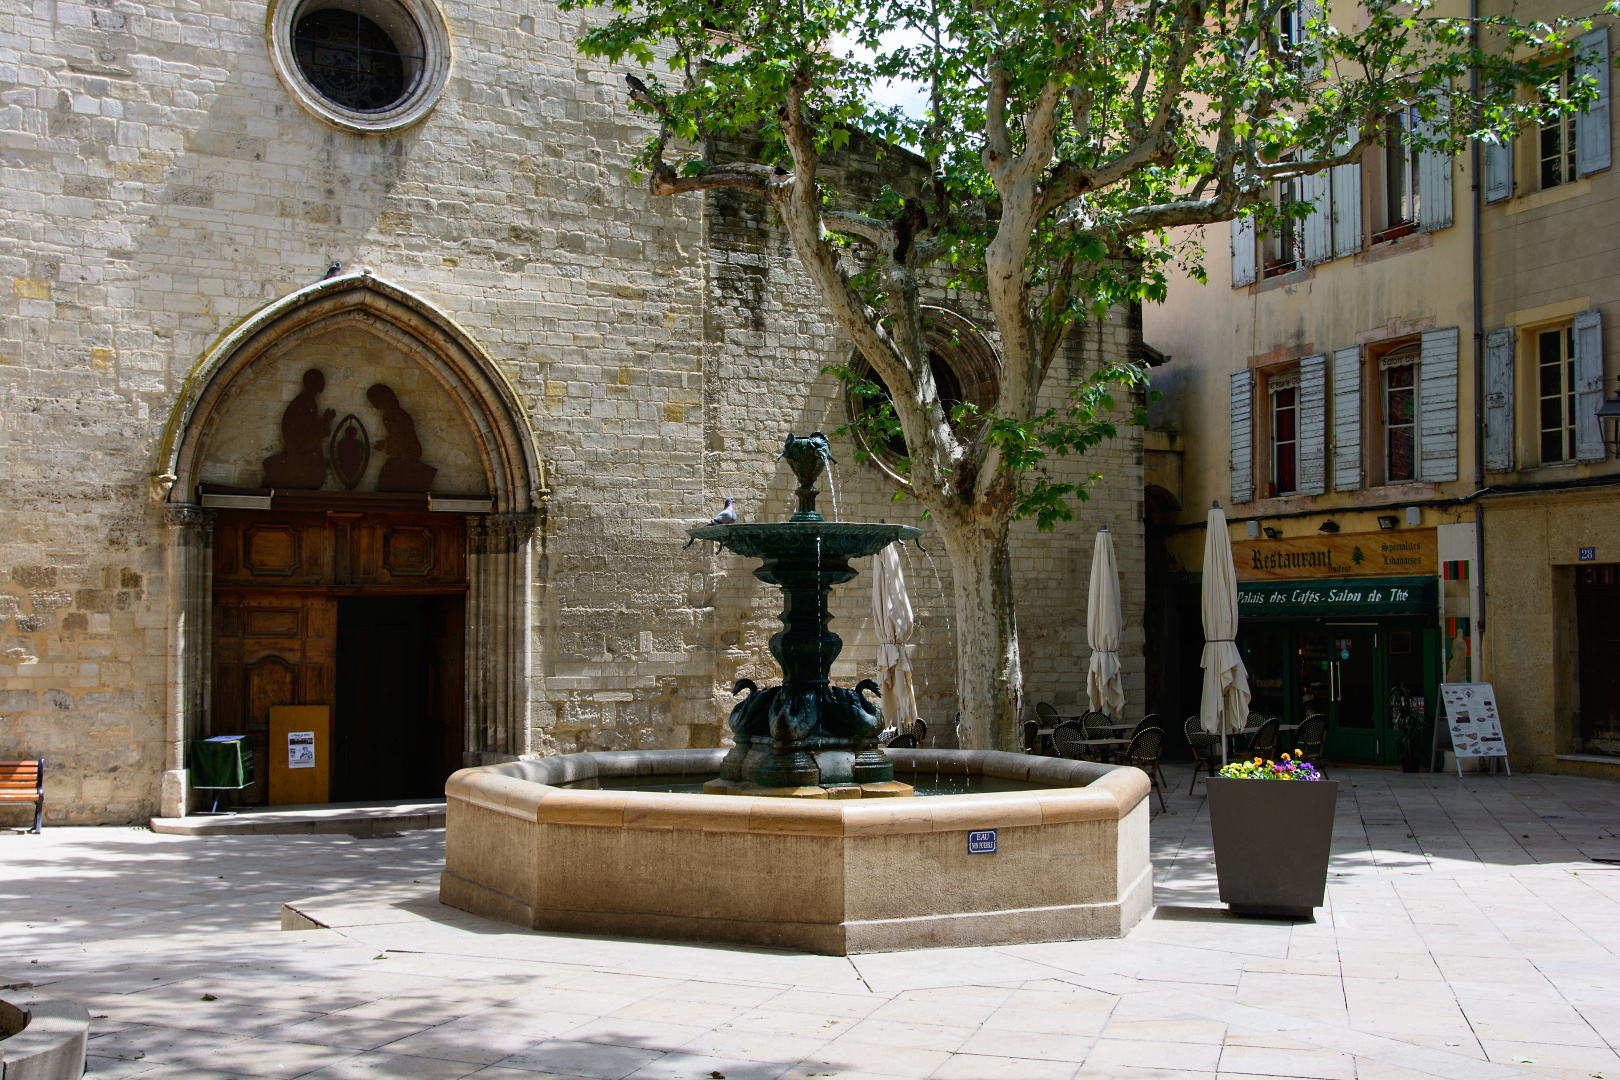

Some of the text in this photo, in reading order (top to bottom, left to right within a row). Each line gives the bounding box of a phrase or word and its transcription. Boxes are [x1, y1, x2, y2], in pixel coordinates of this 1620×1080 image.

[1382, 356, 1402, 366] Salon
[1405, 354, 1415, 363] de
[1251, 548, 1333, 571] Restaurant
[1581, 549, 1593, 559] 28
[1383, 555, 1422, 565] Libanaises
[1237, 591, 1265, 604] Palais
[1269, 591, 1287, 604] des
[1292, 589, 1321, 605] Cafés
[1328, 589, 1362, 603] Salon
[1367, 589, 1382, 602] de
[1390, 588, 1409, 602] Thé
[976, 833, 990, 841] EAU
